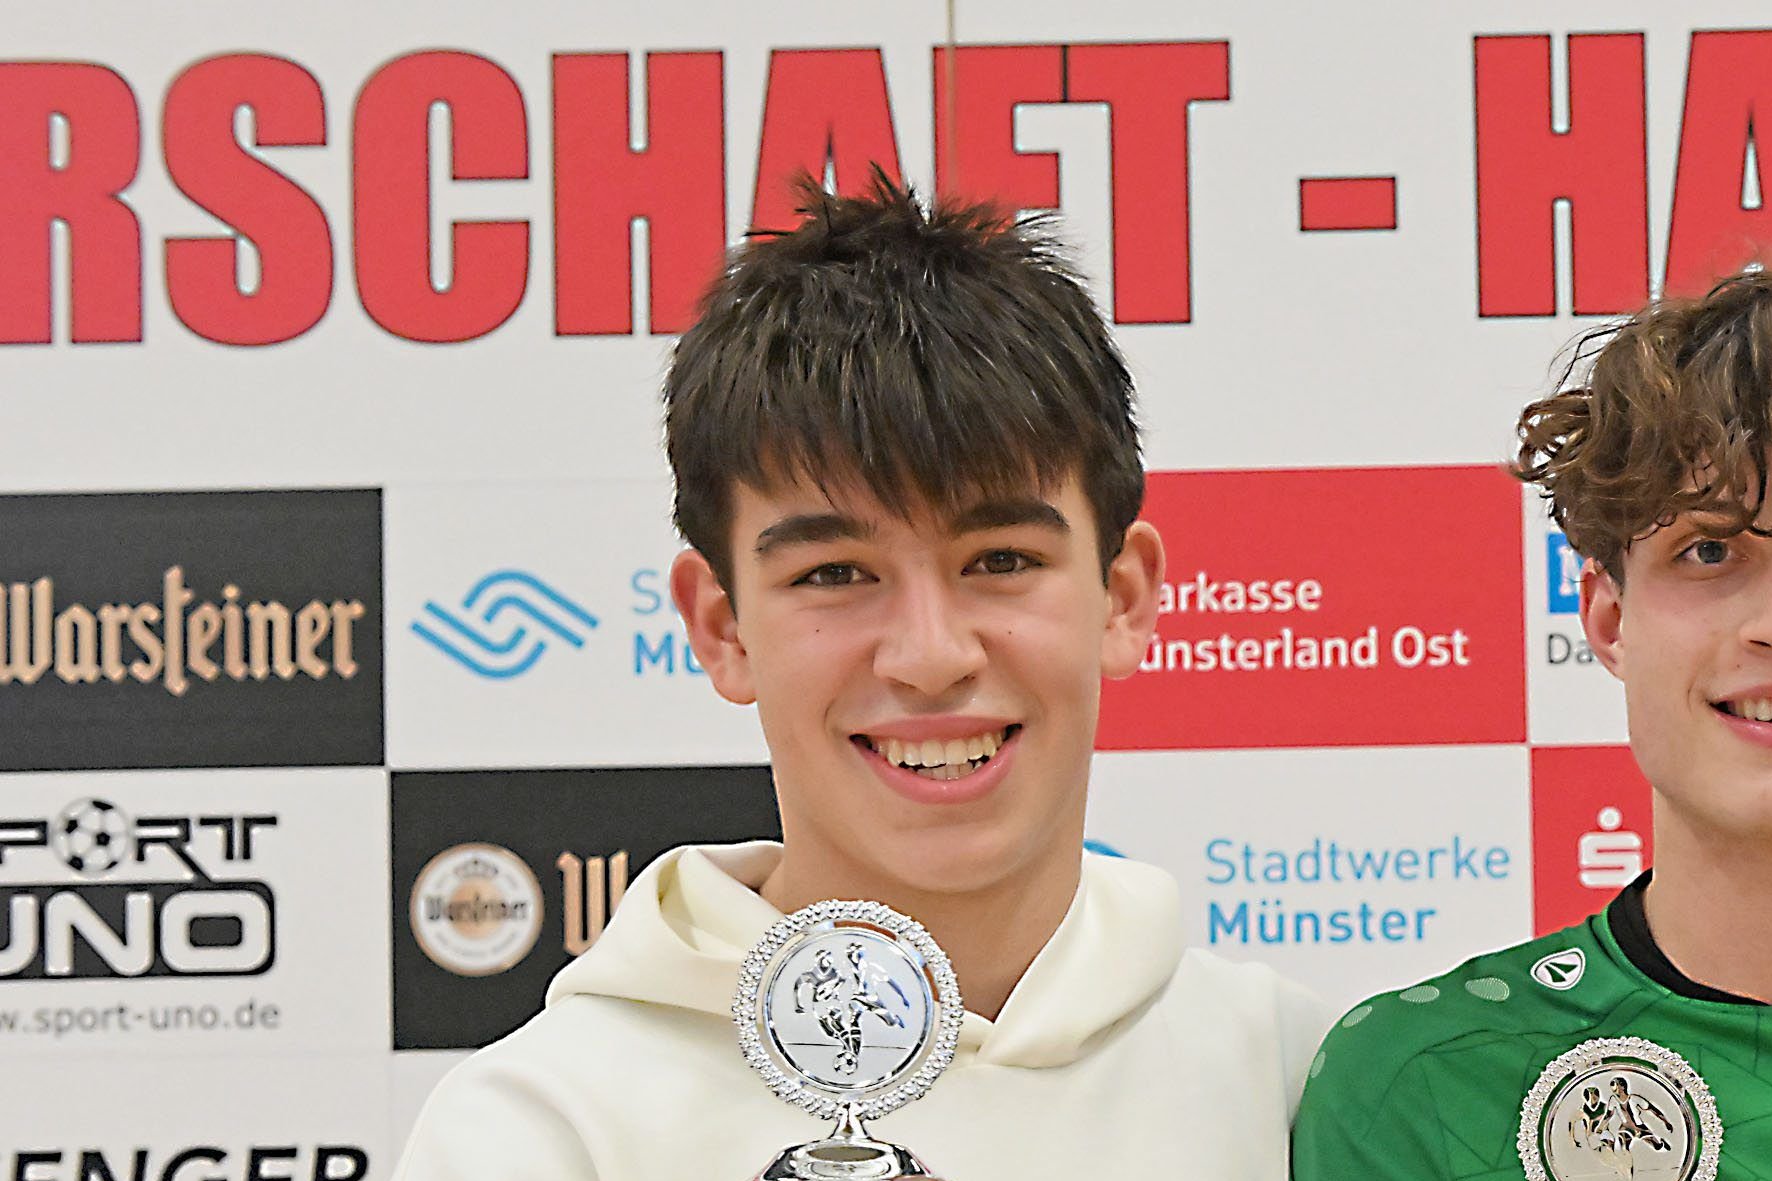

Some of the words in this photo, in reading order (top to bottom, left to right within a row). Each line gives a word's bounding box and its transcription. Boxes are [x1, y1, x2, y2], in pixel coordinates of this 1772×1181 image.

[1392, 626, 1470, 668] Ost
[1206, 836, 1512, 885] Stadtwerke
[1208, 900, 1437, 946] Münster
